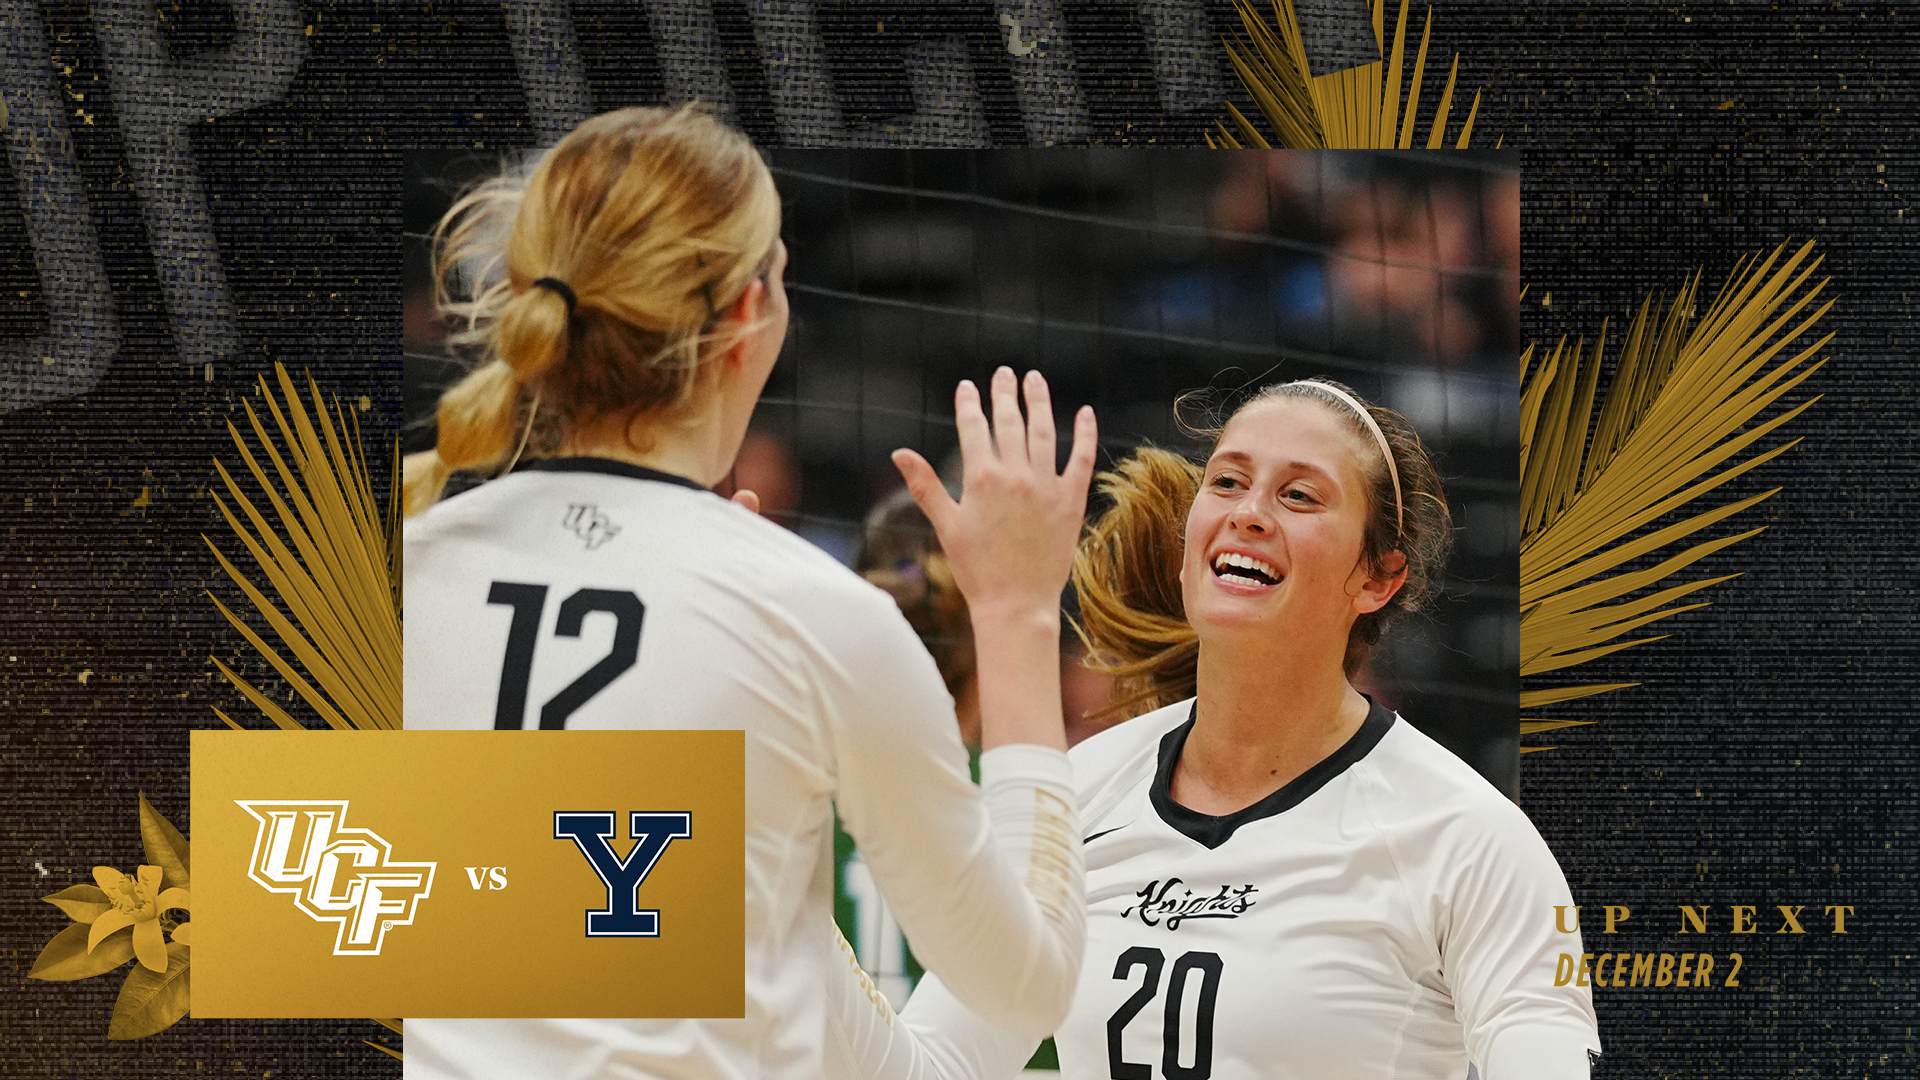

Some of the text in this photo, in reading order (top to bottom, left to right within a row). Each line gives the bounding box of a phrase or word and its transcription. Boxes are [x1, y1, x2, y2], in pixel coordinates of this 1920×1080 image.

[486, 581, 646, 730] 12
[1120, 877, 1259, 931] Knights
[1106, 946, 1224, 1080] 20
